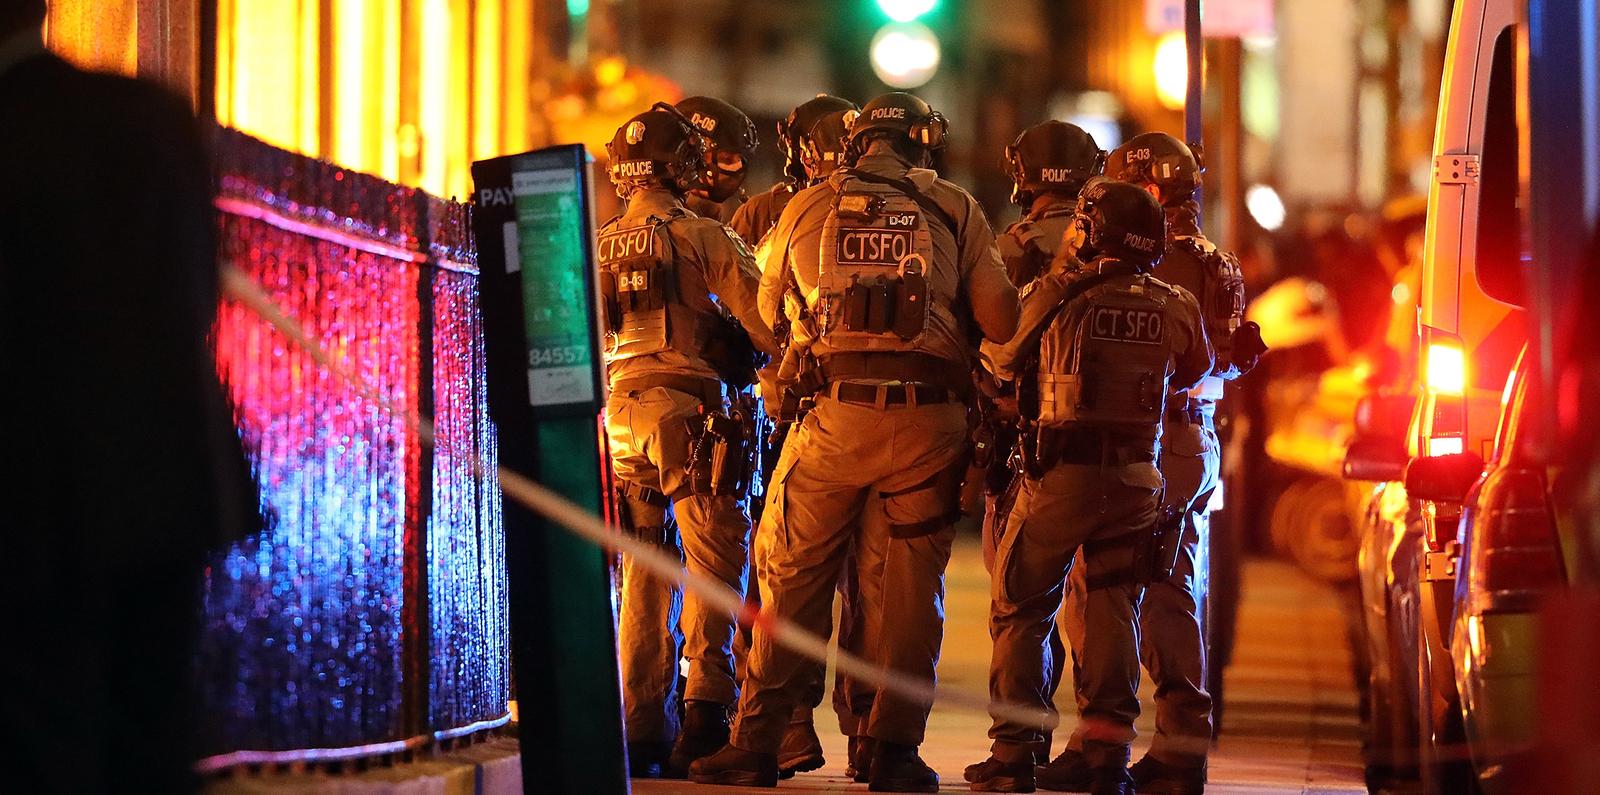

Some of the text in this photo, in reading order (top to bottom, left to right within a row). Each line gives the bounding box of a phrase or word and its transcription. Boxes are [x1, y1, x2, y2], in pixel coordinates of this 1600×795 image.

[871, 107, 905, 120] POLICE
[1126, 148, 1151, 163] E-03
[620, 160, 653, 177] POLICE
[1041, 168, 1072, 181] POLIC
[480, 187, 514, 207] PAY
[889, 215, 915, 226] D-07
[598, 229, 648, 262] CTSFO
[843, 233, 906, 260] CTSFO
[620, 275, 644, 288] D-03
[529, 345, 587, 366] 84557
